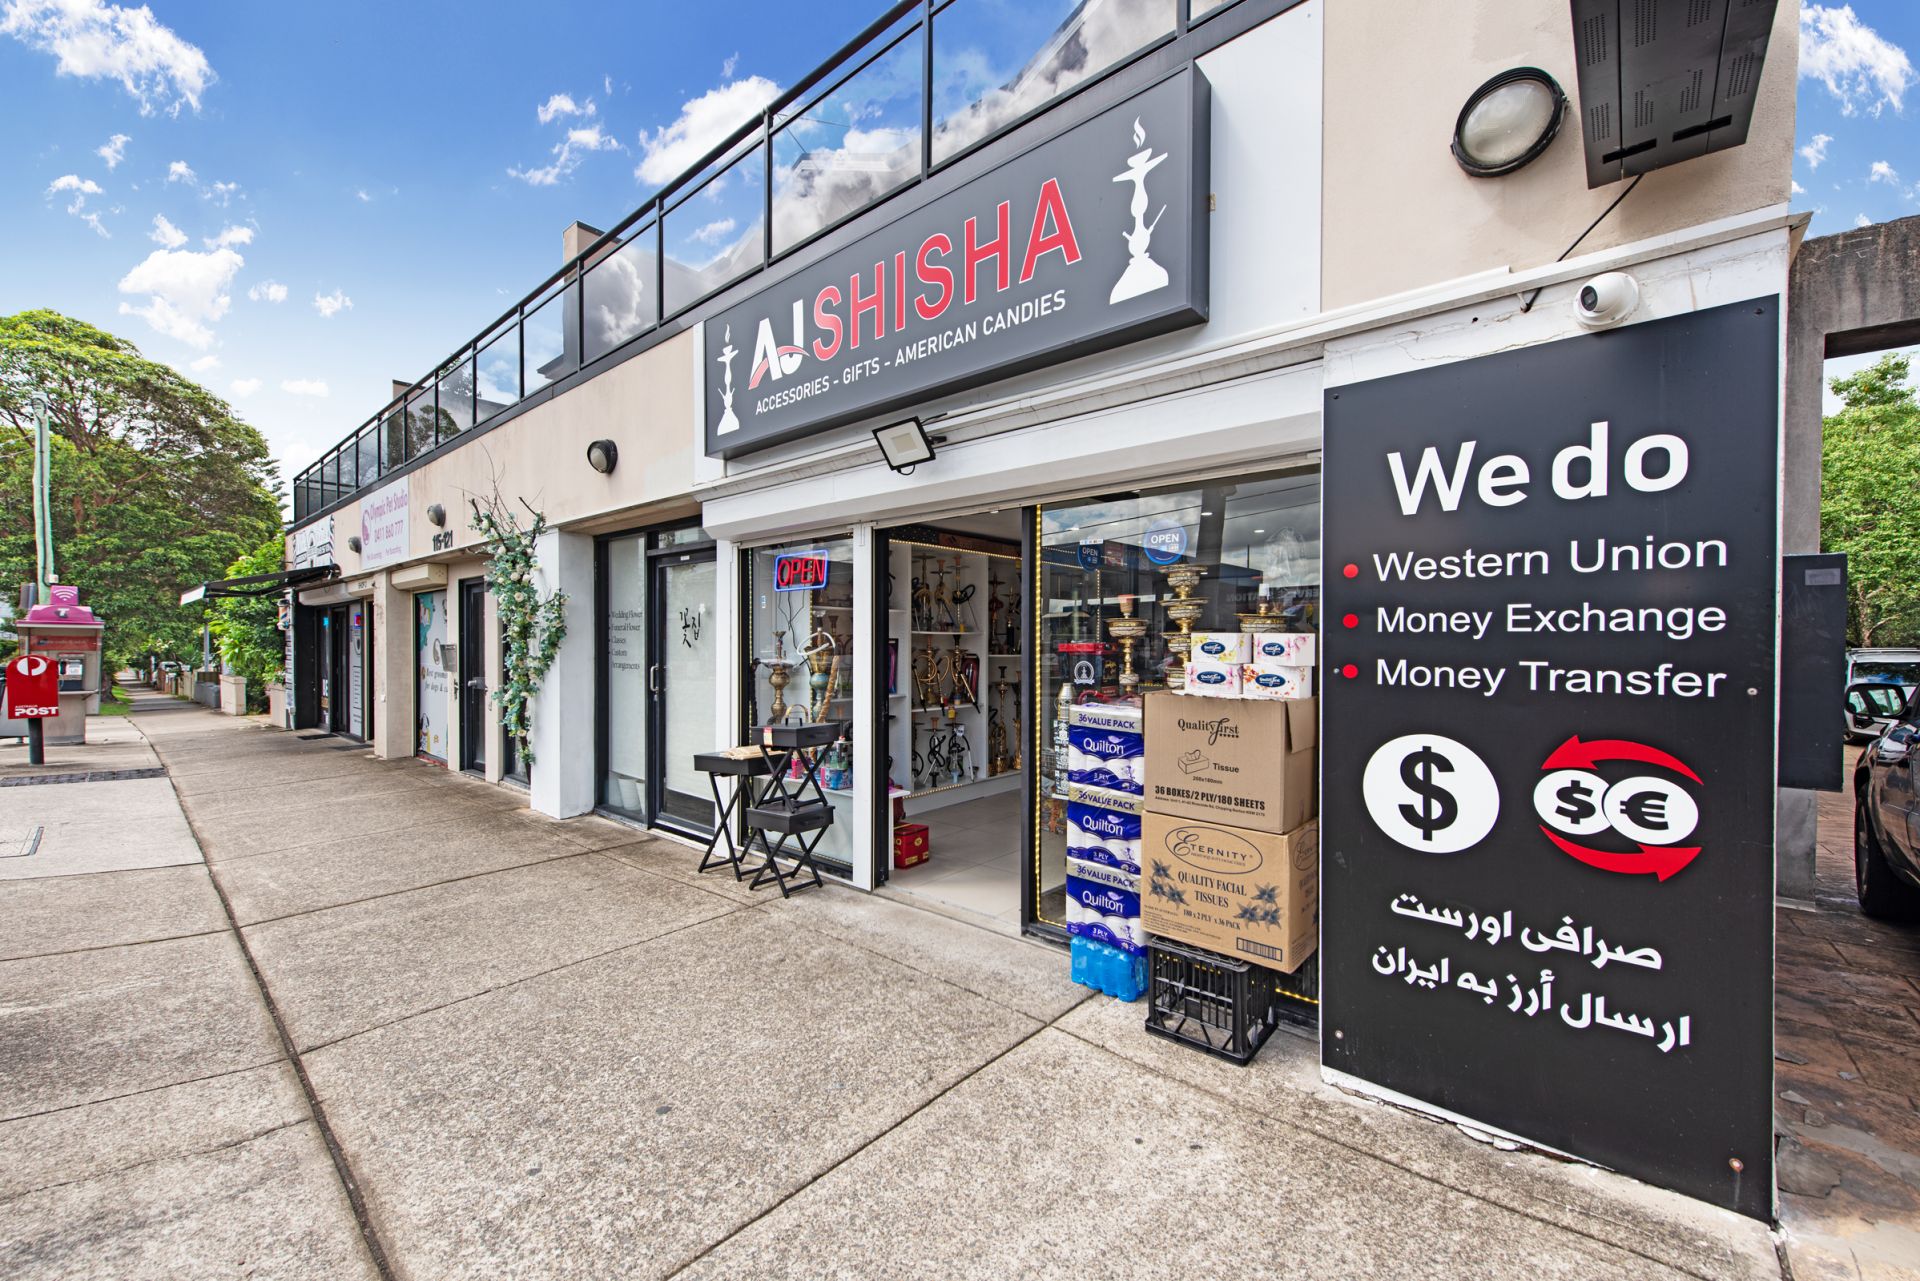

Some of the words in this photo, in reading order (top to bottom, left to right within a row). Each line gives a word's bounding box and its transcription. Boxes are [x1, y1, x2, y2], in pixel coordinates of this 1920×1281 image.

[748, 299, 809, 390] AJ
[813, 177, 1082, 361] SHISHA
[755, 375, 830, 416] ACCESSORIES
[843, 357, 880, 385] GIFTS
[894, 321, 978, 368] AMERICAN
[982, 289, 1067, 337] CANDIES
[1387, 440, 1530, 516] We
[1551, 421, 1690, 501] do
[1082, 546, 1098, 557] OPEN
[1151, 533, 1180, 544] OPEN
[777, 556, 826, 587] OPEN
[1373, 547, 1549, 582] Western
[1570, 535, 1727, 573] Union
[1376, 606, 1493, 640] Money
[1506, 602, 1727, 640] Exchange
[1376, 658, 1506, 697] Money
[1518, 661, 1727, 698] Transfer
[15, 707, 58, 716] POST
[1113, 719, 1136, 729] PACK
[1083, 737, 1124, 754] Quilton
[1212, 762, 1240, 774] Tissue
[1113, 799, 1135, 811] PACK
[1155, 785, 1165, 795] 36
[1166, 787, 1200, 801] BOXES/2
[1200, 792, 1233, 806] PLY/180
[1233, 797, 1266, 811] SHEETS
[1083, 815, 1123, 836] Quilton
[1113, 875, 1135, 888] PACK
[1178, 871, 1215, 889] QUALITY
[1216, 879, 1247, 897] FACIAL
[1082, 890, 1123, 913] Quilton
[1194, 890, 1229, 908] TISSUES
[1201, 913, 1212, 922] PLY
[1225, 919, 1241, 930] PACK
[1390, 893, 1512, 946] اورست
[1520, 915, 1662, 970] صرافی
[1372, 945, 1449, 990] ایران
[1457, 971, 1499, 1005] به
[1559, 992, 1691, 1053] ارسال
